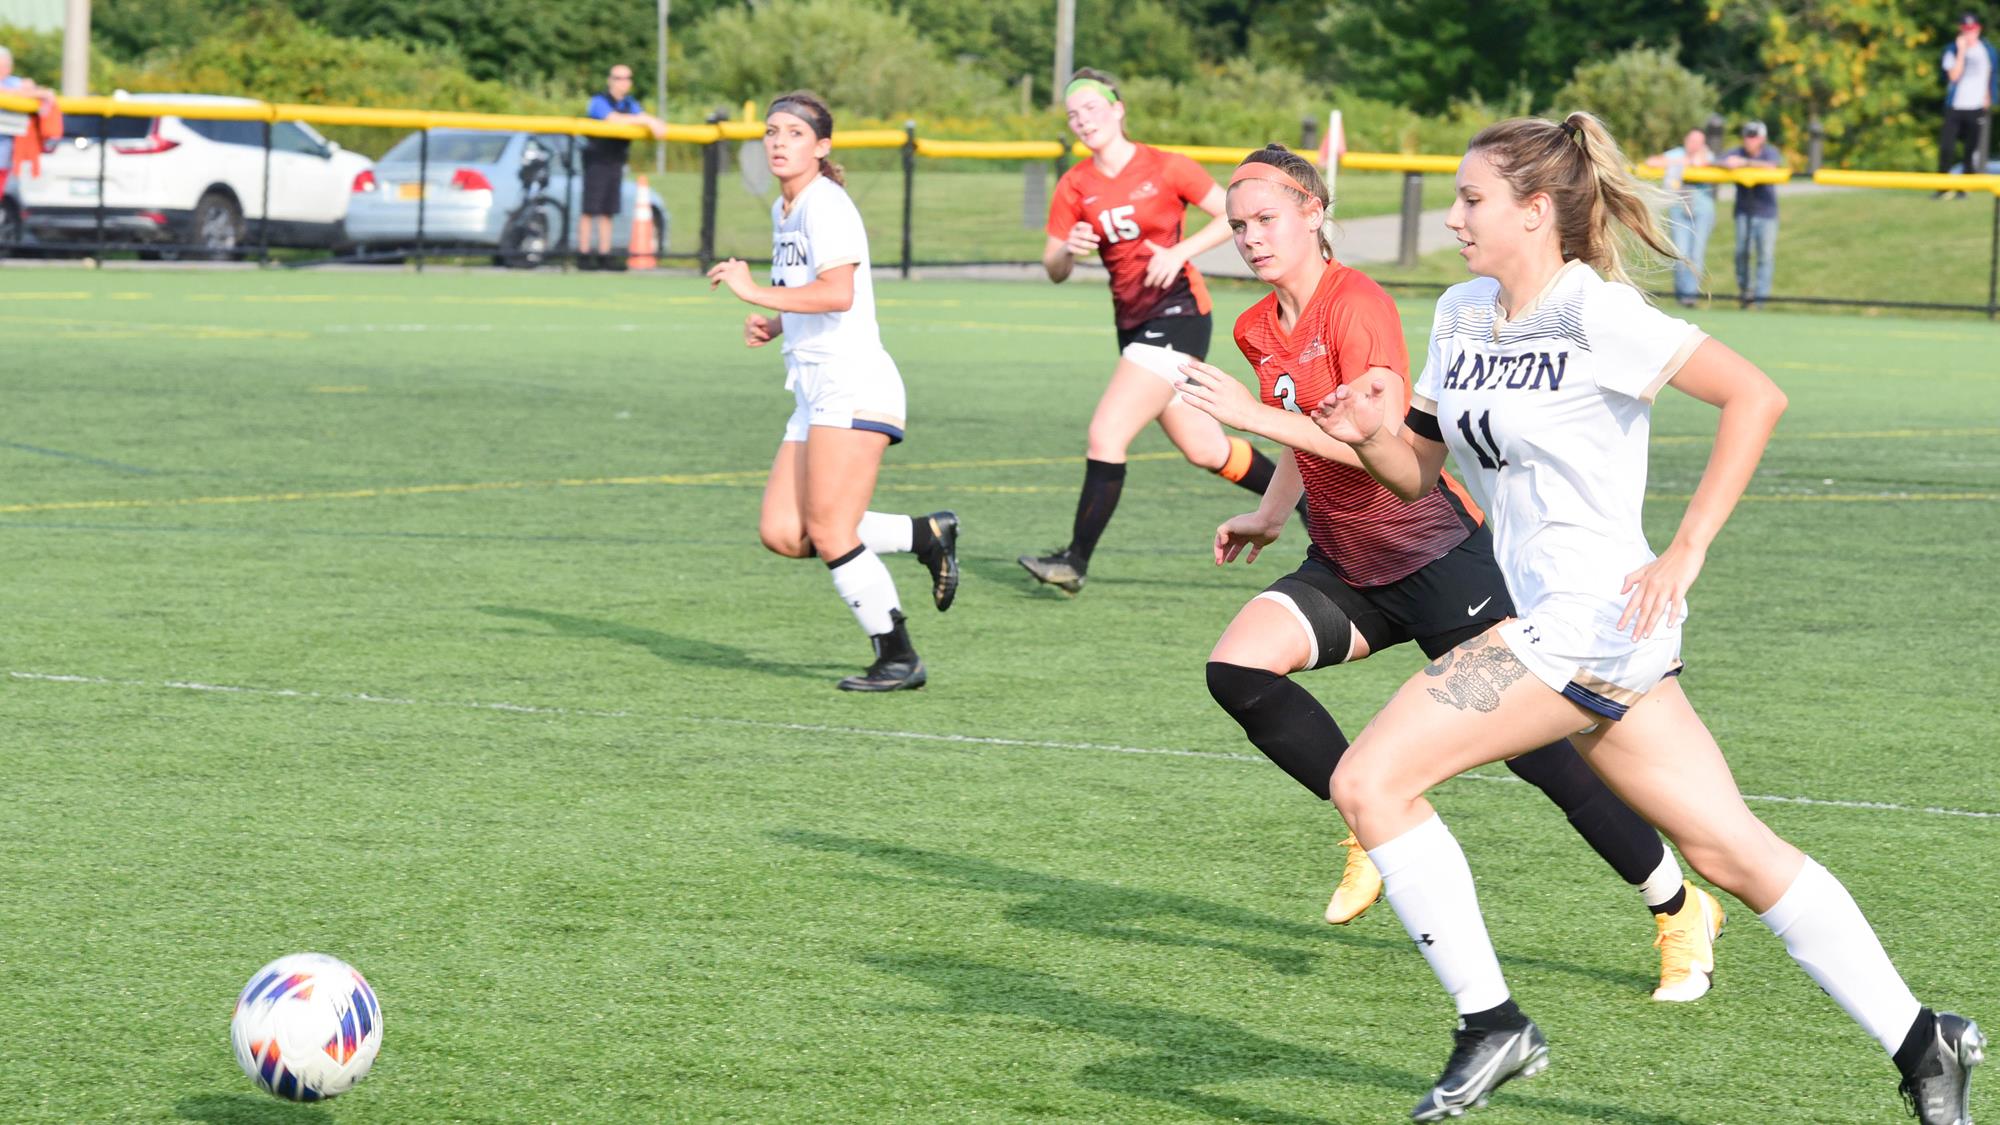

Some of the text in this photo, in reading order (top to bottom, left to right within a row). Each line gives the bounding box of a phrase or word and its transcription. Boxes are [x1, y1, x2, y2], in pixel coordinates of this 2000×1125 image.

[1098, 204, 1141, 244] 15
[1444, 349, 1569, 391] ANTON
[1457, 410, 1509, 472] 11
